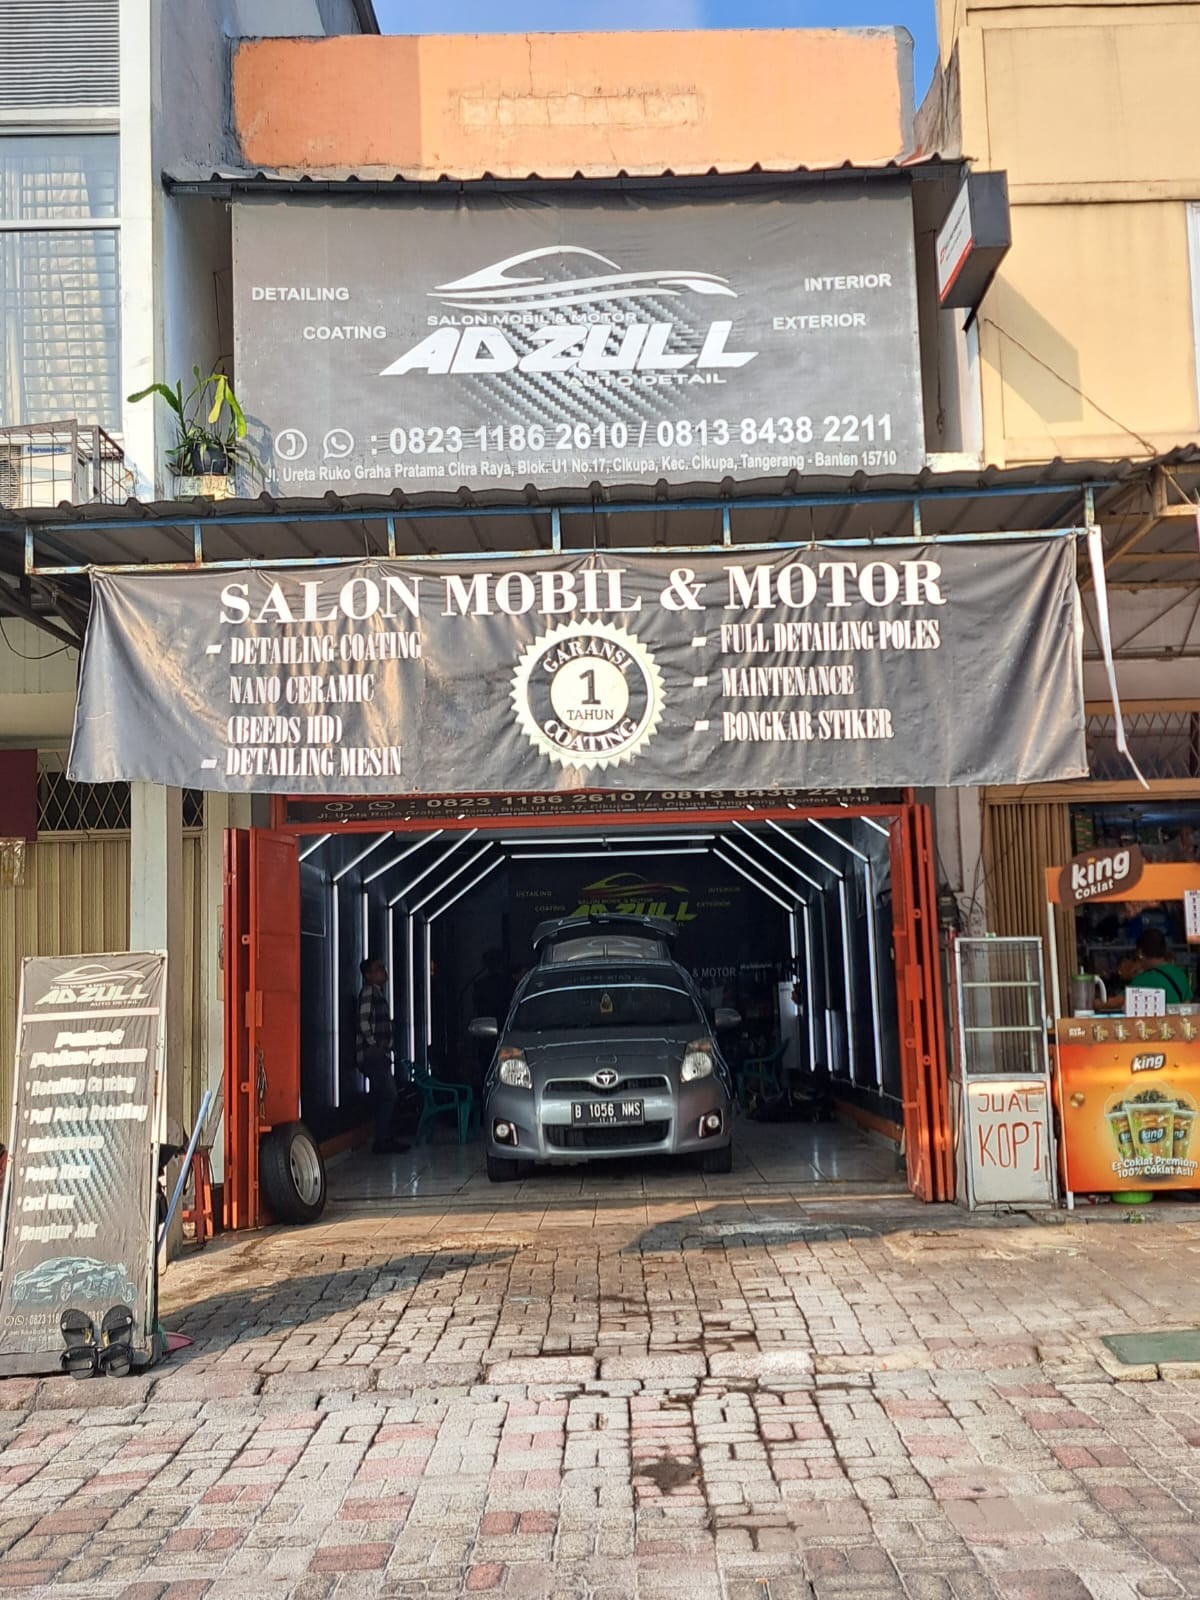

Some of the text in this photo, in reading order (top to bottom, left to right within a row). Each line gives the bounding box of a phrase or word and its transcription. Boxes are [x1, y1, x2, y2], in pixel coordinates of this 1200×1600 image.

[251, 287, 350, 302] DETAILING
[804, 273, 892, 292] INTERIOR
[303, 326, 388, 340] COATING
[427, 315, 488, 326] SALON
[493, 313, 551, 325] MOBIL
[570, 312, 638, 323] MOTOR
[773, 312, 866, 331] EXTERIOR
[378, 320, 760, 376] ADZULL
[566, 373, 728, 388] AUTO DETAIL
[389, 427, 463, 454] 0823
[474, 424, 546, 451] 1186
[555, 422, 629, 450] 2610
[656, 418, 731, 447] 0813
[740, 415, 814, 444] 8438
[823, 413, 893, 442] 2211
[284, 467, 317, 482] Ureta
[320, 465, 352, 480] Ruko
[355, 463, 392, 479] Graha
[395, 462, 446, 477] Pratama
[448, 460, 478, 475] Citra
[481, 459, 516, 478] Raya,
[518, 457, 551, 475] Blok.
[552, 456, 569, 472] U1
[613, 455, 660, 473] Cikupa,
[662, 453, 690, 470] Kec.
[692, 452, 738, 471] Cikupa,
[741, 451, 805, 469] Tangerang
[815, 450, 859, 466] Banten
[861, 449, 897, 465] 15710
[218, 560, 947, 625] SALON MOBIL & MOTOR
[230, 631, 423, 665] DETAILING COATING
[720, 619, 941, 653] FULL DETAILING POLES
[543, 641, 634, 673] GARANSI
[229, 673, 375, 704] NANO CERAMIC
[579, 669, 602, 705] 1
[721, 665, 855, 697] MAINTENANCE
[226, 715, 343, 744] (BEEDS HD)
[566, 710, 615, 721] TAHUN
[722, 708, 895, 742] BONGKAR STIKER
[543, 718, 638, 753] COATING
[226, 746, 402, 777] DETAILING MESIN
[427, 798, 491, 808] 0823
[501, 795, 563, 806] 1186
[572, 792, 636, 803] 2610
[661, 790, 724, 800] 0813
[1072, 850, 1130, 889] king
[1075, 879, 1114, 899] Coklat
[35, 984, 149, 1005] ADZULL
[1133, 1054, 1164, 1071] king
[575, 1102, 641, 1118] B 1056 NMS
[978, 1093, 1040, 1113] JUAL
[978, 1121, 1043, 1171] KOPI
